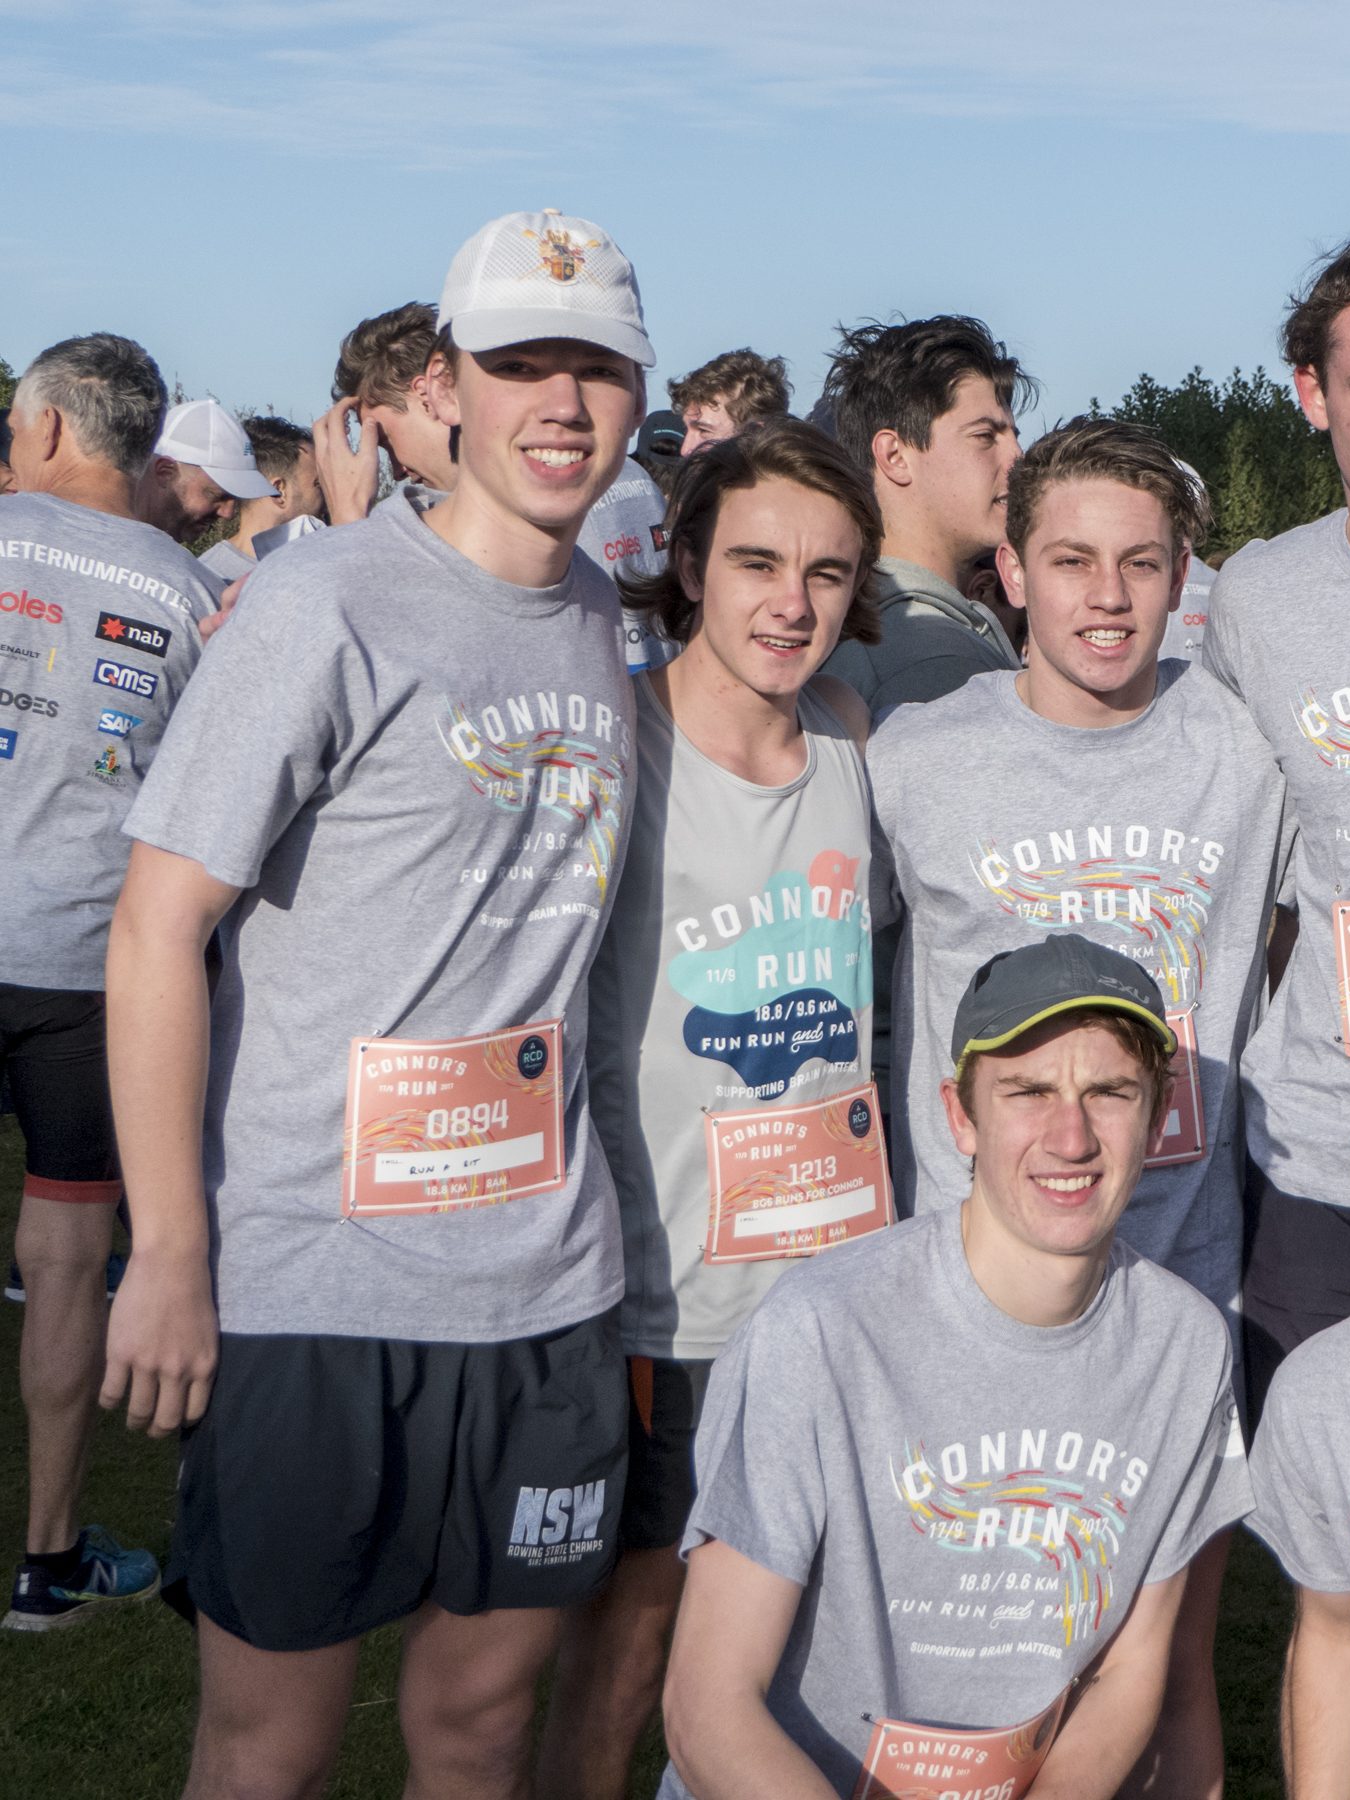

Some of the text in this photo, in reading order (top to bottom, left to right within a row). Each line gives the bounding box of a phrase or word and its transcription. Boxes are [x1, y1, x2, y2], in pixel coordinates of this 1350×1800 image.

[0, 590, 63, 624] oles
[1183, 613, 1207, 626] cole
[127, 625, 165, 648] nab
[0, 644, 41, 659] ENAULT
[100, 712, 133, 734] SAP
[980, 825, 1224, 888] CONNOR'S
[573, 863, 608, 879] PAR
[1015, 888, 1195, 924] 17/9 RUN 2017
[1132, 946, 1155, 959] KM
[706, 946, 833, 989] 11/9 RUN
[819, 999, 838, 1014] KM
[701, 1020, 855, 1053] FUN RUN and PAR
[366, 1055, 468, 1079] CONNOR'S
[523, 1048, 544, 1063] RCD
[398, 1080, 438, 1097] RUN
[715, 1067, 821, 1101] SUPPORTING BRAIN
[427, 1099, 510, 1140] 0894
[851, 1110, 868, 1124] RCD
[721, 1121, 808, 1149] CONNOR'S
[751, 1143, 784, 1162] RUN
[788, 1155, 838, 1187] 1213
[450, 1183, 468, 1194] KM
[805, 1185, 826, 1200] FOR
[827, 1176, 864, 1197] CONNOR
[903, 1429, 1149, 1500] CONNOR'S
[510, 1479, 606, 1545] NSW
[928, 1507, 1110, 1548] 17/9 RUN 2017
[507, 1540, 604, 1557] ROWING STATE CHAMPS
[1035, 1576, 1059, 1591] KM
[888, 1599, 1097, 1630] FUN RUN and PARTY
[910, 1641, 1063, 1659] SUPPORTING BRAIN MATTERS
[886, 1740, 989, 1765] CONNOR'S
[913, 1762, 954, 1779] RUN
